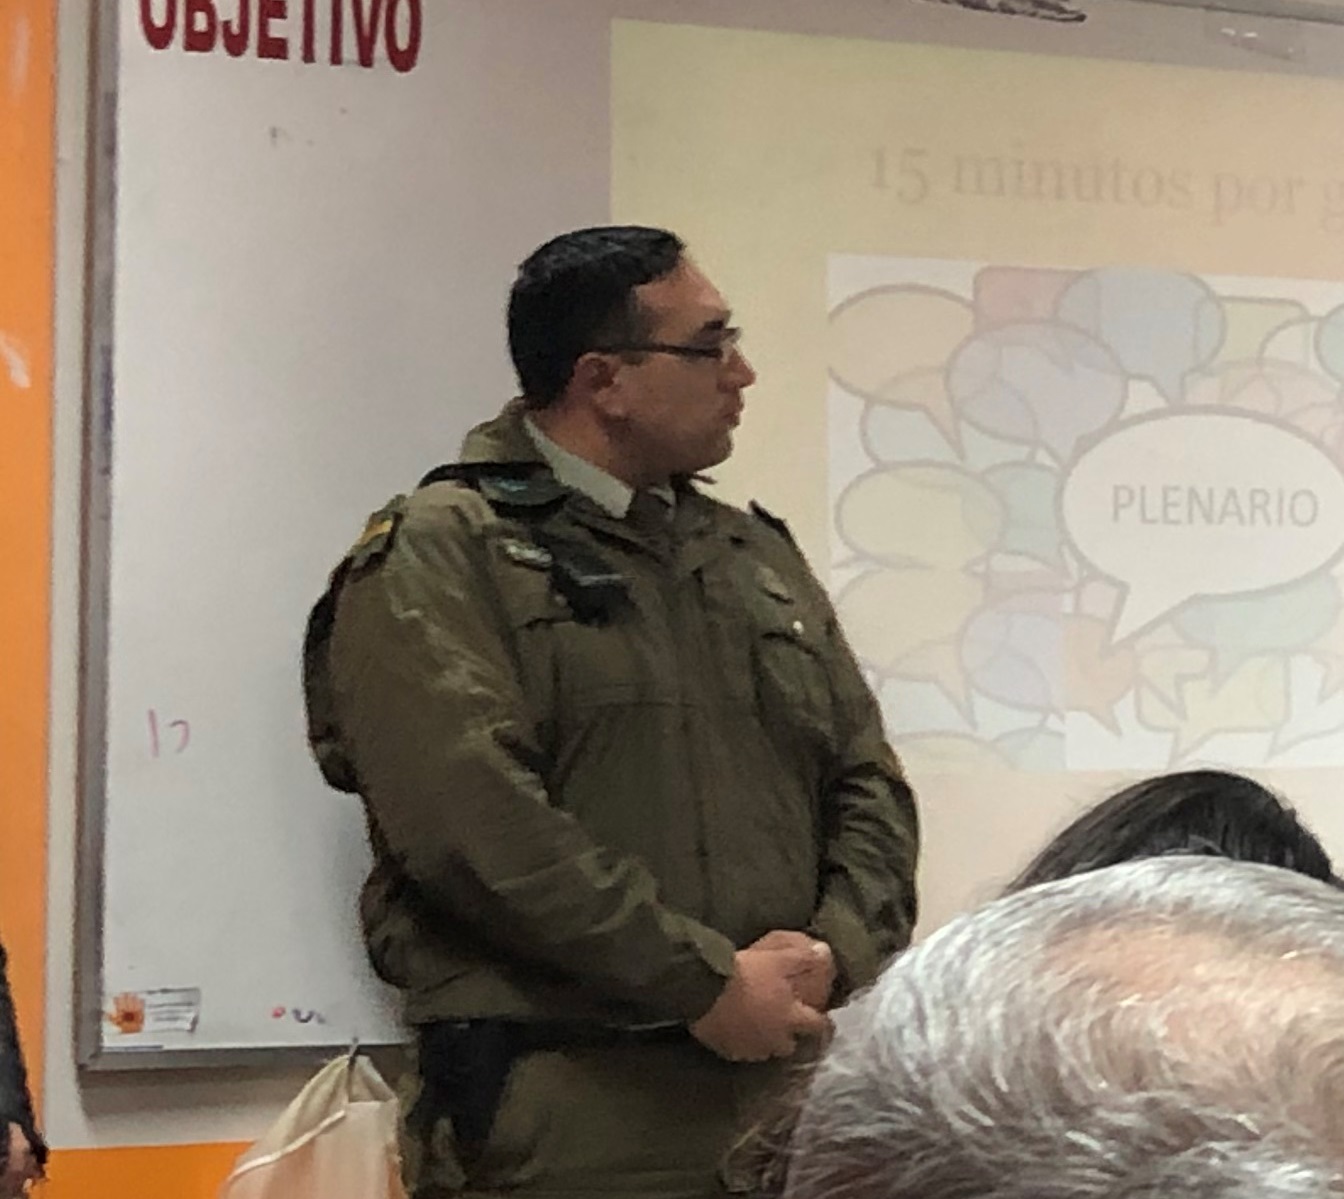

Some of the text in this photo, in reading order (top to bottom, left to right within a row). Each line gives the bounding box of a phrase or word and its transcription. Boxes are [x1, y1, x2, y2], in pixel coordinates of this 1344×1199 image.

[139, 0, 422, 73] OBJETIVO
[952, 143, 1193, 211] minutos
[1210, 170, 1306, 227] por
[1112, 484, 1319, 527] PLENARIO
